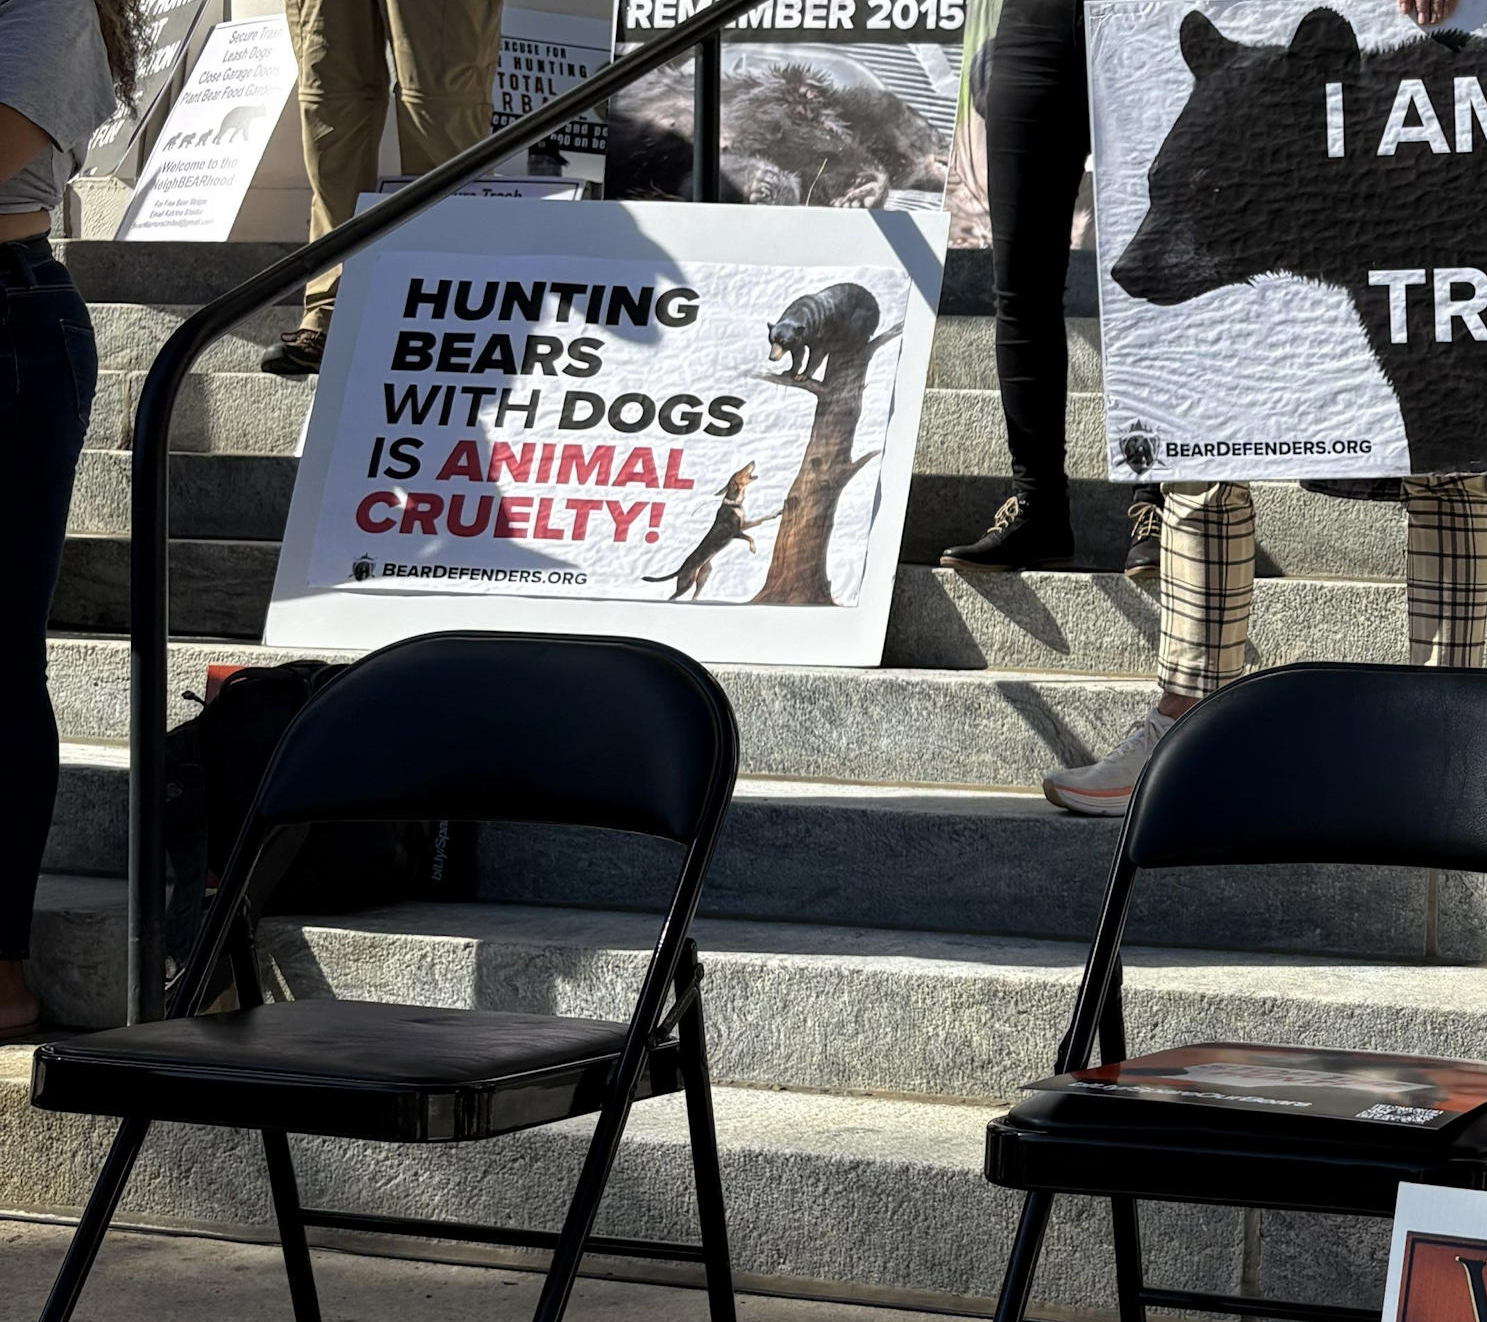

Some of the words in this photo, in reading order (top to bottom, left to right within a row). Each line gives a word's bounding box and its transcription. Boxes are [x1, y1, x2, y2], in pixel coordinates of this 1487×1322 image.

[229, 30, 258, 44] Secure
[222, 47, 249, 63] Leash
[500, 40, 540, 55] XCUSE
[546, 46, 567, 59] FOR
[199, 70, 221, 85] Close
[514, 56, 588, 78] HUNTING
[201, 89, 222, 102] Bear
[222, 86, 245, 100] Food
[497, 71, 557, 96] TOTAL
[1325, 81, 1345, 159] I
[162, 160, 206, 174] Welcome
[402, 277, 701, 329] HUNTING
[392, 330, 605, 378] BEARS
[382, 382, 539, 431] WITH
[557, 389, 745, 439] DOGS
[366, 436, 423, 481] IS
[436, 438, 697, 492] ANIMAL
[354, 489, 664, 546] CRUELTY!
